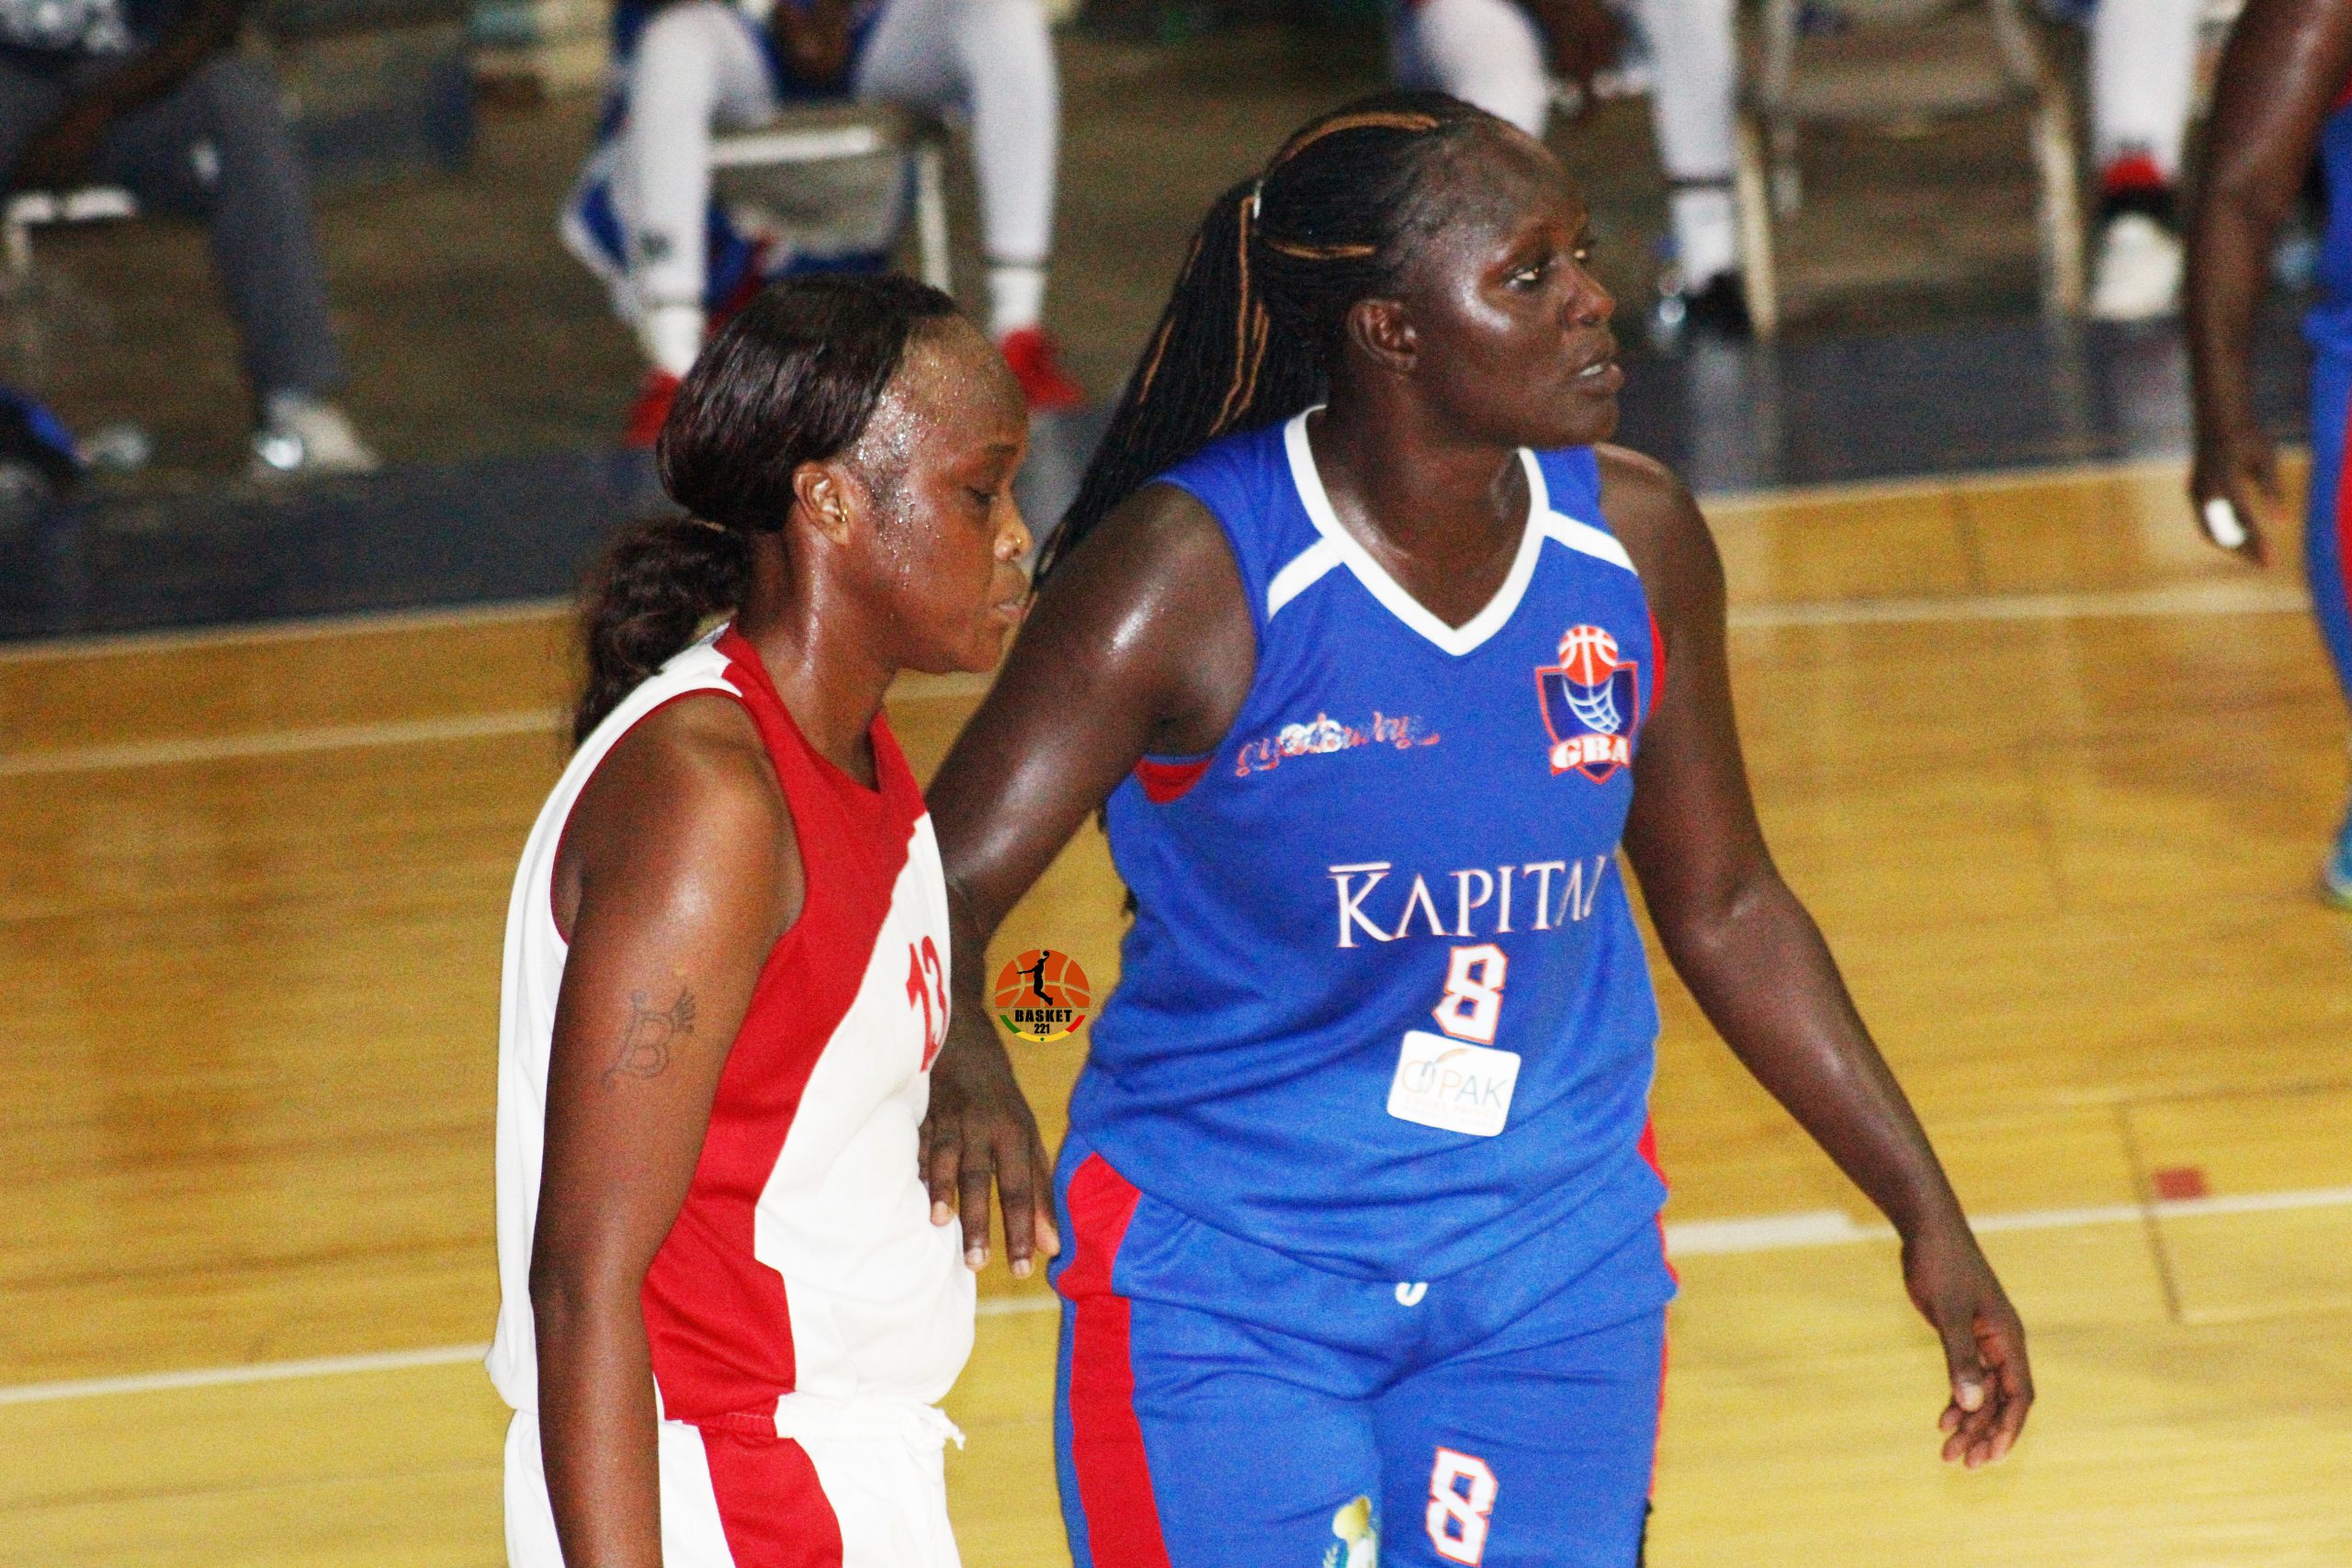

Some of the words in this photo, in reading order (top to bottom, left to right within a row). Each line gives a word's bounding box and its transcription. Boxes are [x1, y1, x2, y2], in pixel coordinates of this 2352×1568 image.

[1551, 735, 1630, 769] GBA
[1432, 942, 1509, 1045] 8
[1426, 1446, 1499, 1568] 8
